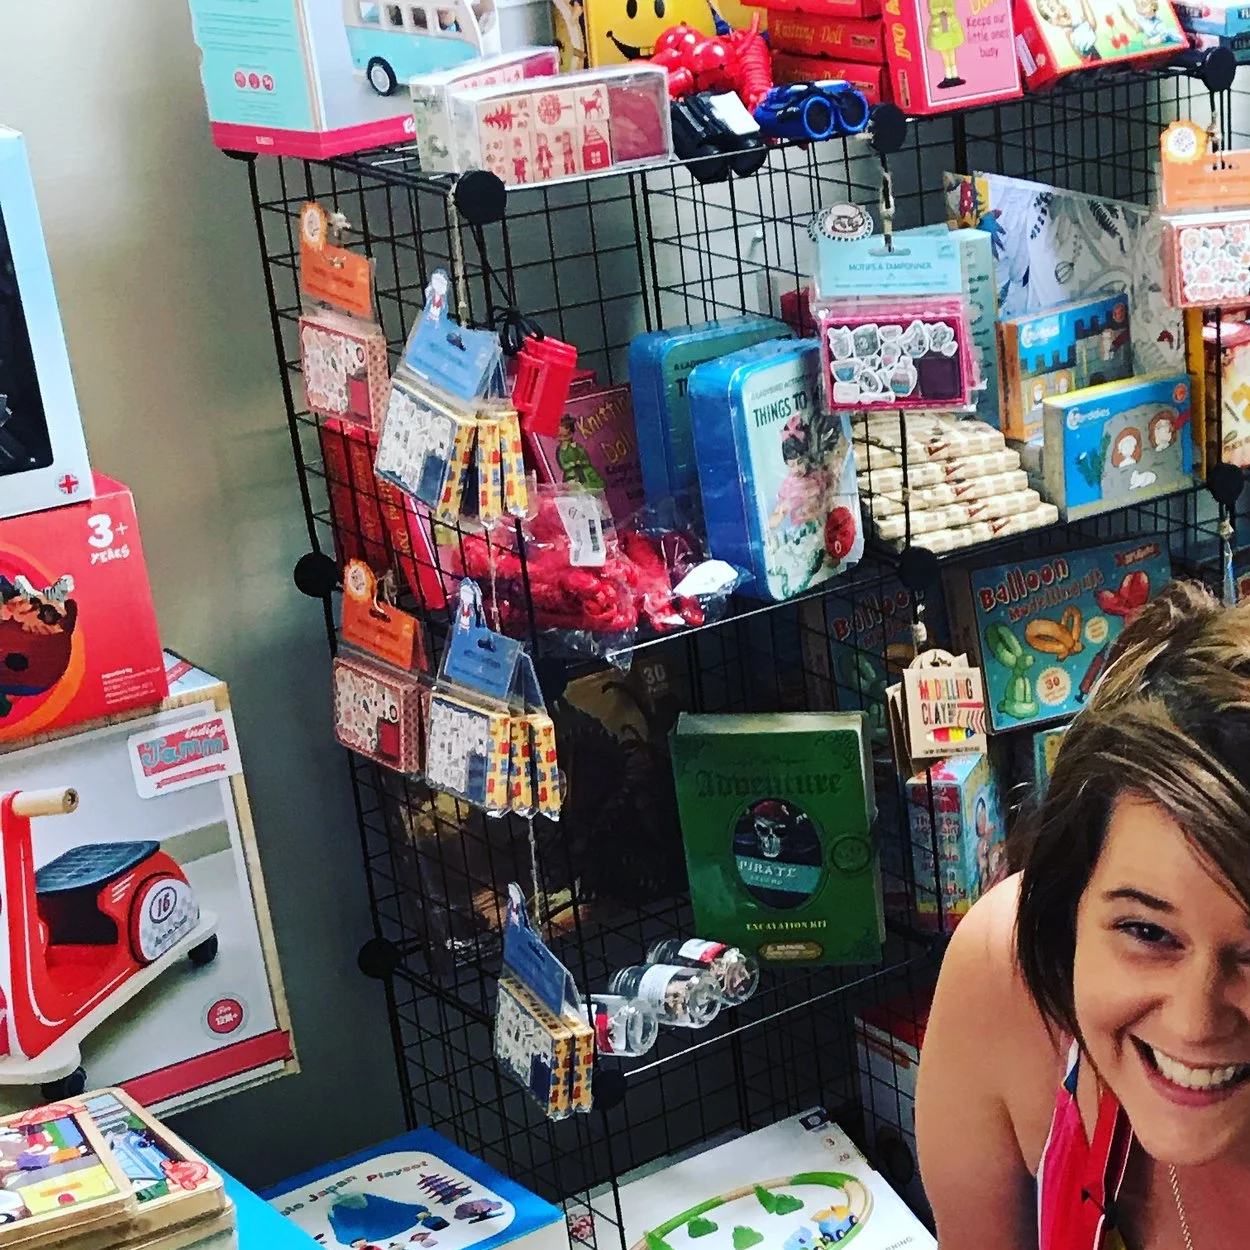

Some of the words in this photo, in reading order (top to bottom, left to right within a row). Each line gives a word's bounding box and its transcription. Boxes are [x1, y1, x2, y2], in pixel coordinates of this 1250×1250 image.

[821, 24, 844, 45] Doll
[753, 397, 792, 428] THINGS
[792, 391, 808, 416] TO
[90, 544, 130, 565] YEARS
[979, 558, 1070, 612] Balloon
[918, 678, 973, 701] MODELLING
[1045, 677, 1060, 690] 30
[921, 702, 947, 725] CLAY
[184, 723, 225, 739] indigo
[142, 737, 224, 768] Jamm
[696, 769, 843, 798] Adventure
[738, 860, 798, 879] PIRATE
[308, 1175, 357, 1203] Japan
[366, 1160, 429, 1182] Playset
